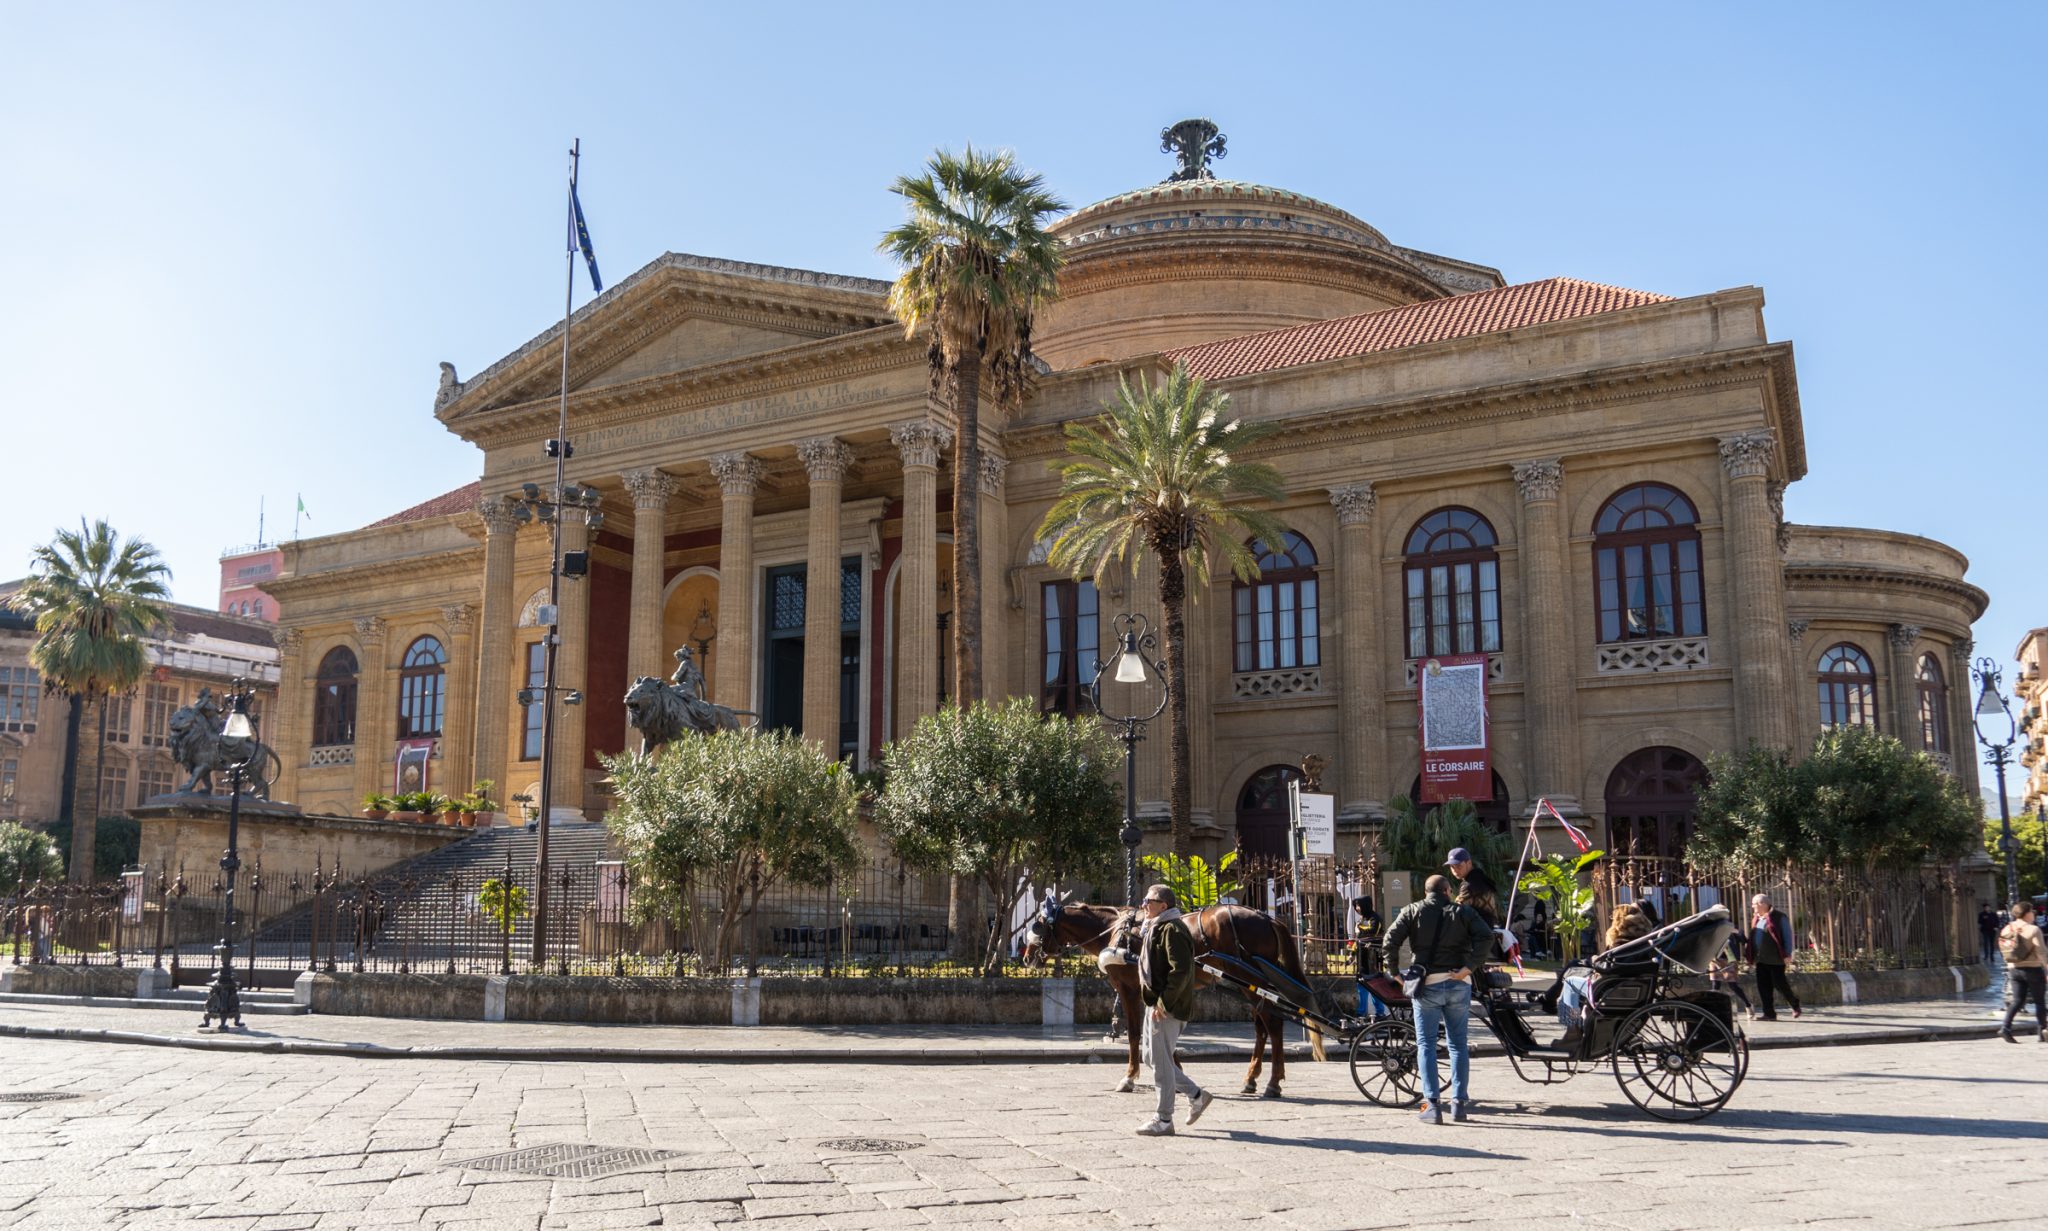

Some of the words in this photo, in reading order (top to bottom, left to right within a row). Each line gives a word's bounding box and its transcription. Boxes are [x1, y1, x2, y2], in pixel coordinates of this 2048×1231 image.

[585, 424, 639, 443] RINNOVA
[740, 395, 787, 413] RIVELA
[796, 391, 810, 402] LA
[816, 383, 849, 398] VITA
[1425, 764, 1437, 773] LE
[1438, 761, 1485, 772] CORSAIRE
